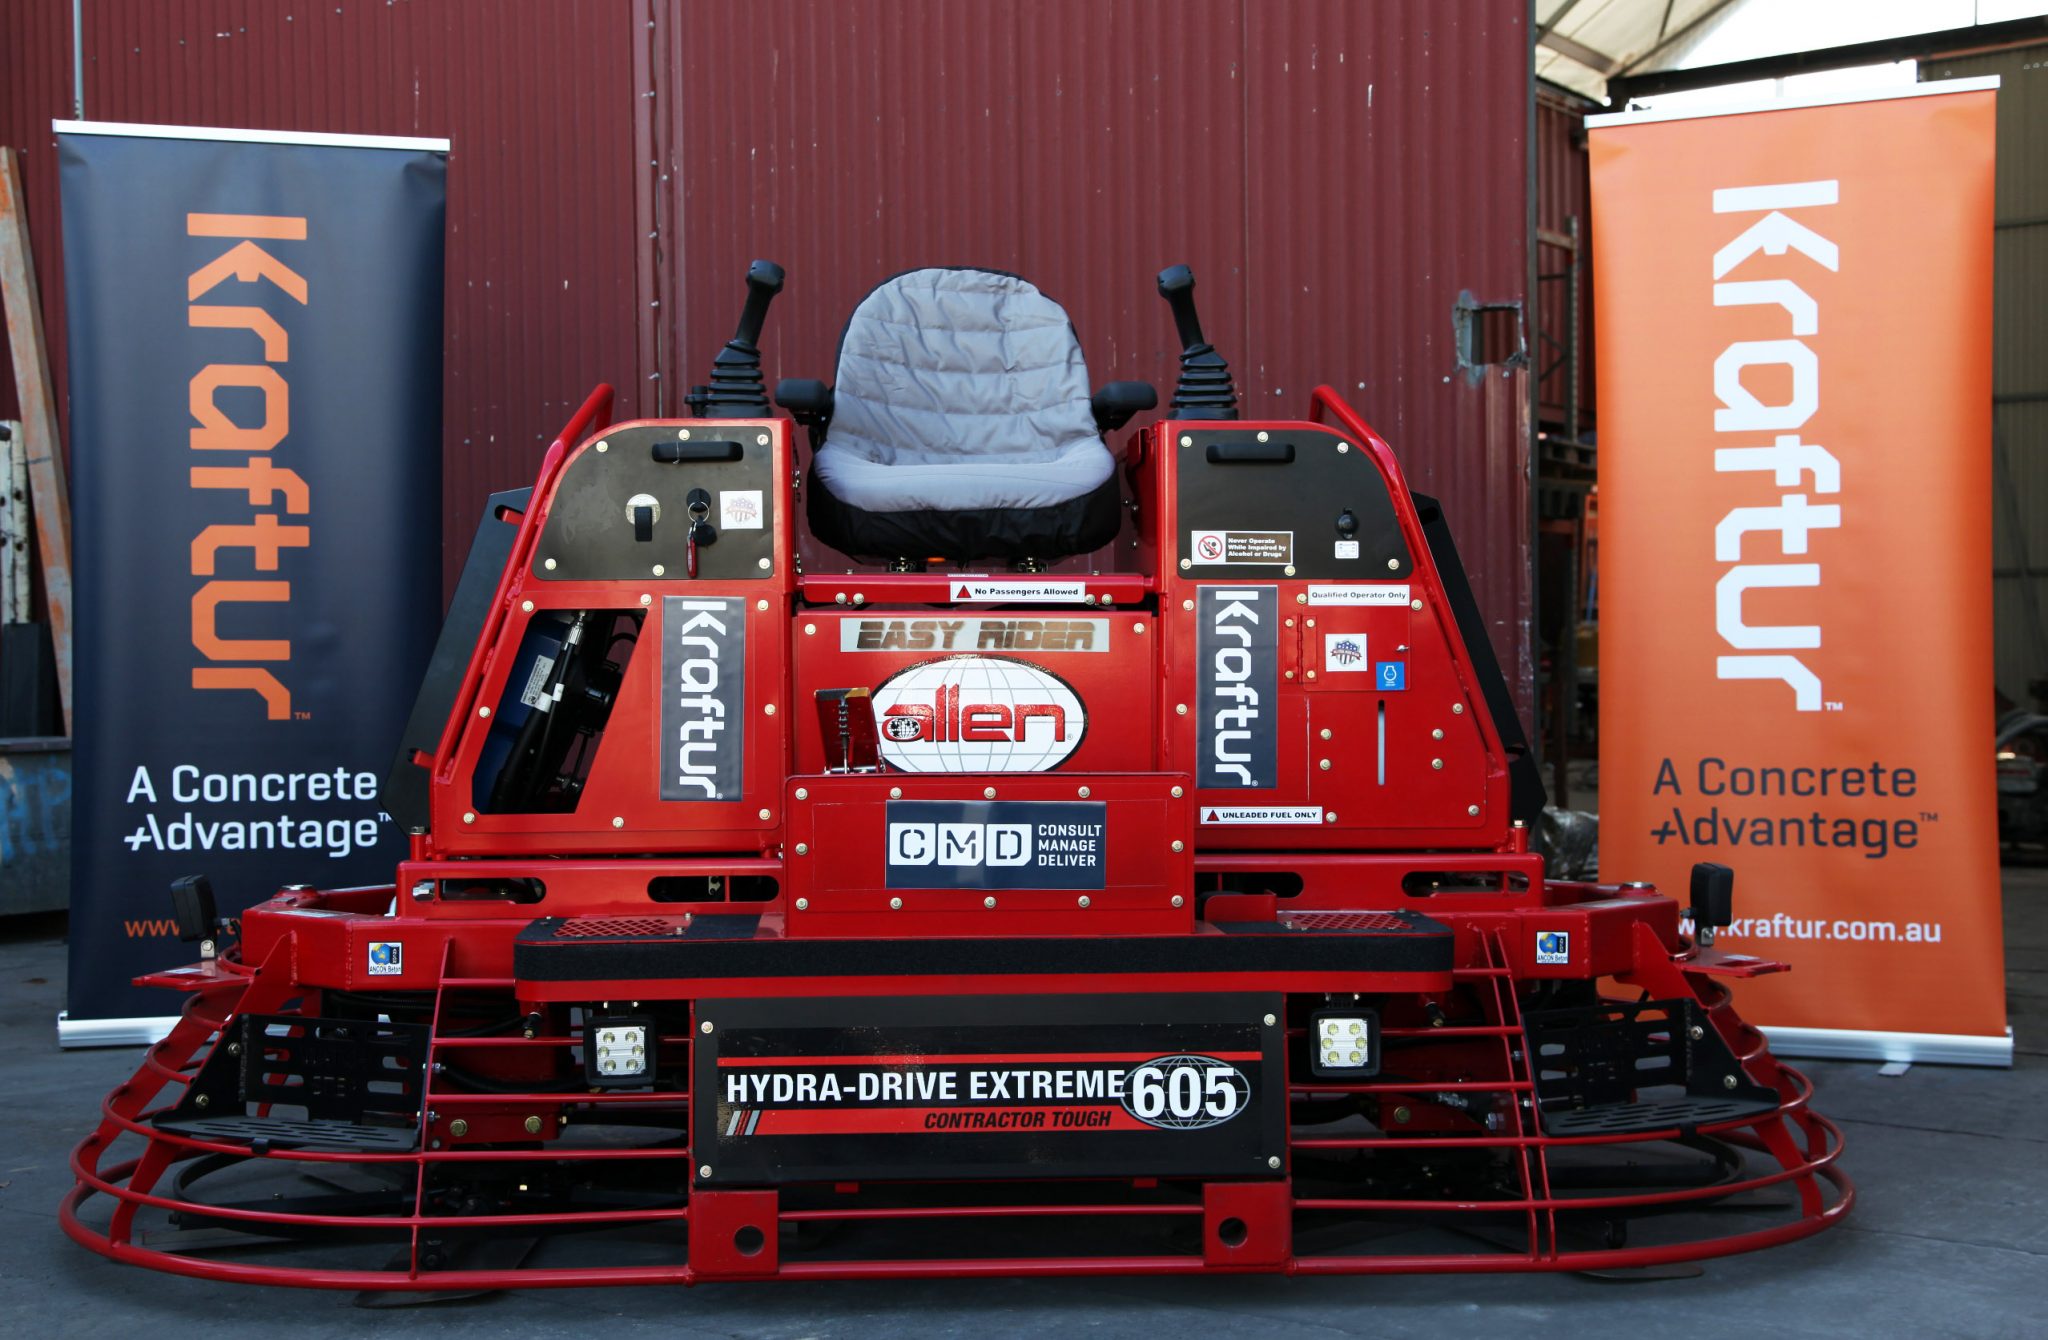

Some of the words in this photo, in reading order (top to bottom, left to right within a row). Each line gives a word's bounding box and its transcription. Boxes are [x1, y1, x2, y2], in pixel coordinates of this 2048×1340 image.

[1712, 179, 1840, 711] Kraftur
[187, 213, 309, 720] Kraftur
[990, 588, 1041, 597] Passengers
[1388, 592, 1406, 600] Only
[857, 620, 964, 649] EASY
[977, 620, 1096, 649] RIDER
[679, 600, 727, 799] Kraftur
[1215, 590, 1259, 786] Kraftur
[882, 683, 1066, 742] allen
[126, 765, 158, 804] A
[172, 764, 377, 803] Concrete
[1652, 757, 1682, 796] A
[1698, 757, 1917, 798] Concrete
[895, 826, 1027, 862] CMD
[1038, 824, 1102, 837] CONSULT
[1038, 839, 1096, 852] MANAGE
[1038, 854, 1097, 867] DELIVER
[1678, 912, 1942, 943] w.kraftur.com.au
[727, 1071, 957, 1103] HYDRA-DRIVE
[970, 1069, 1126, 1100] EXTREME
[1131, 1066, 1237, 1119] 605
[924, 1111, 1045, 1129] CONTRACTOR
[1051, 1109, 1112, 1128] TOUGH
